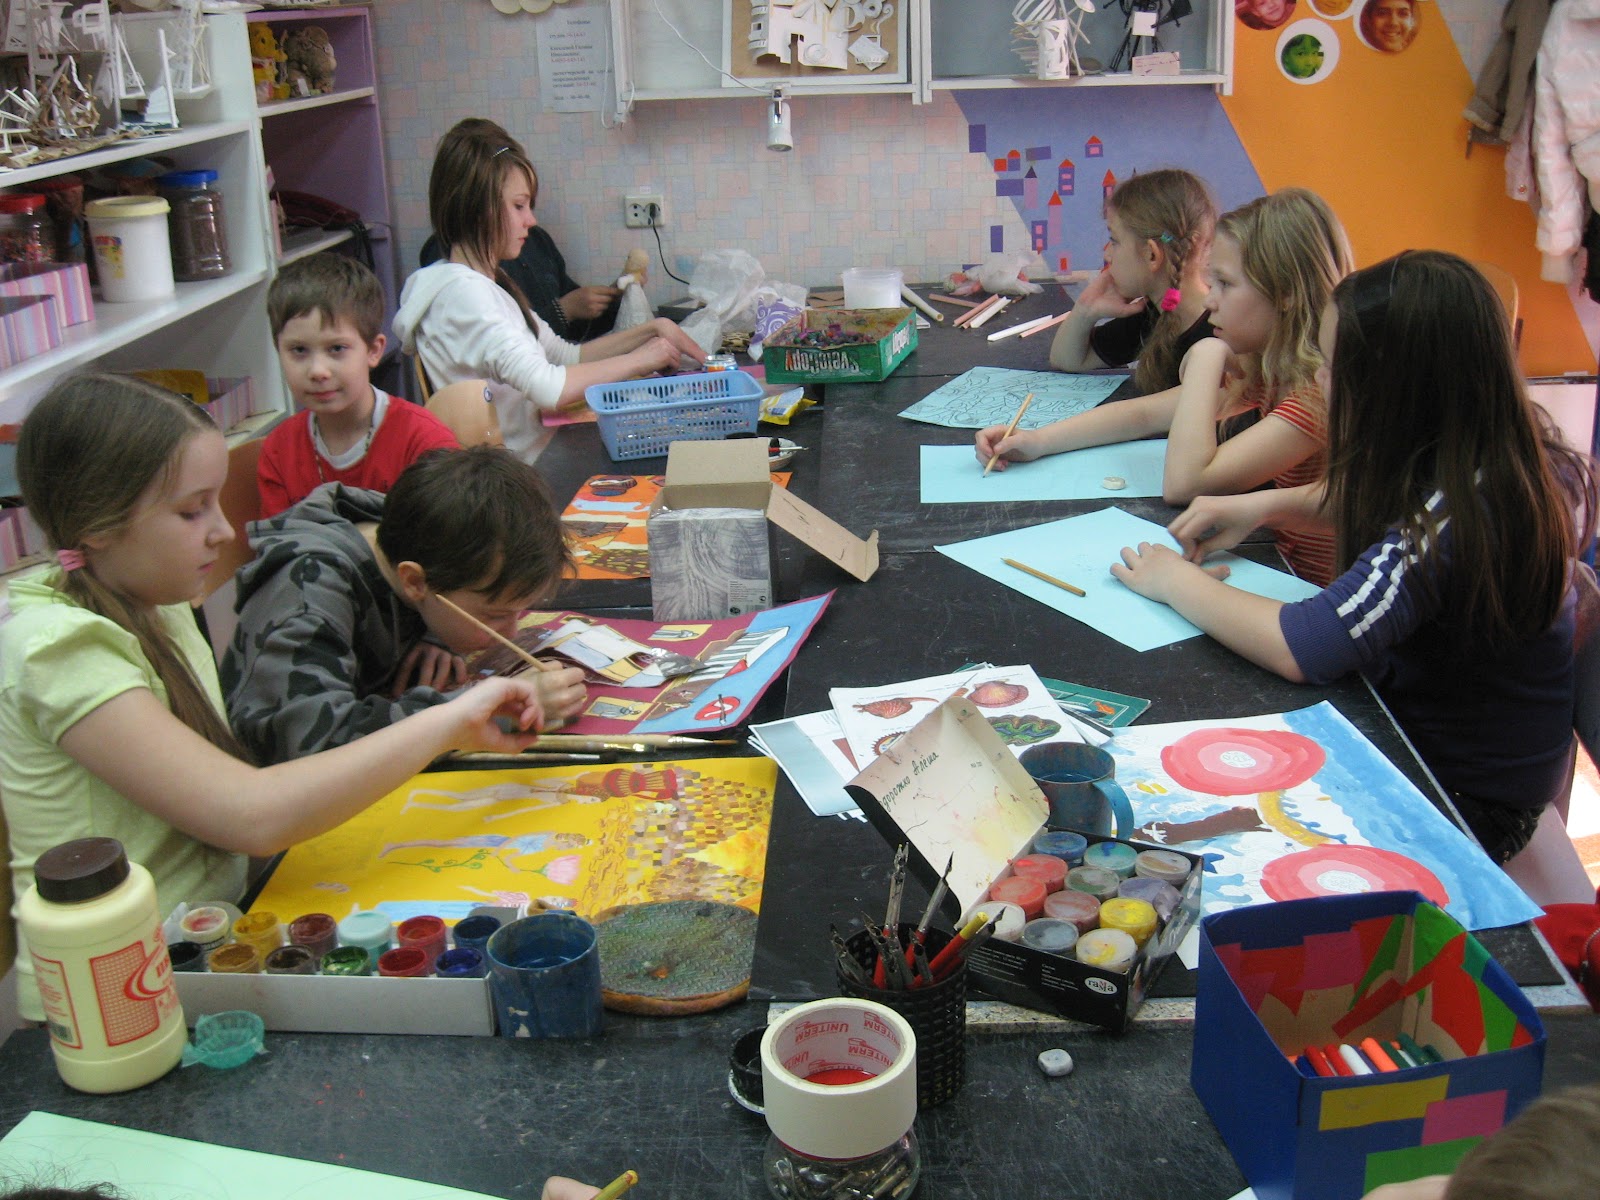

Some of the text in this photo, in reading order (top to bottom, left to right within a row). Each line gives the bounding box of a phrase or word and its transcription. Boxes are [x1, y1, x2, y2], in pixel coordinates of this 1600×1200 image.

[785, 348, 859, 373] SvetoCopy
[795, 1023, 849, 1043] UNITERM
[863, 1020, 902, 1048] NITERM
